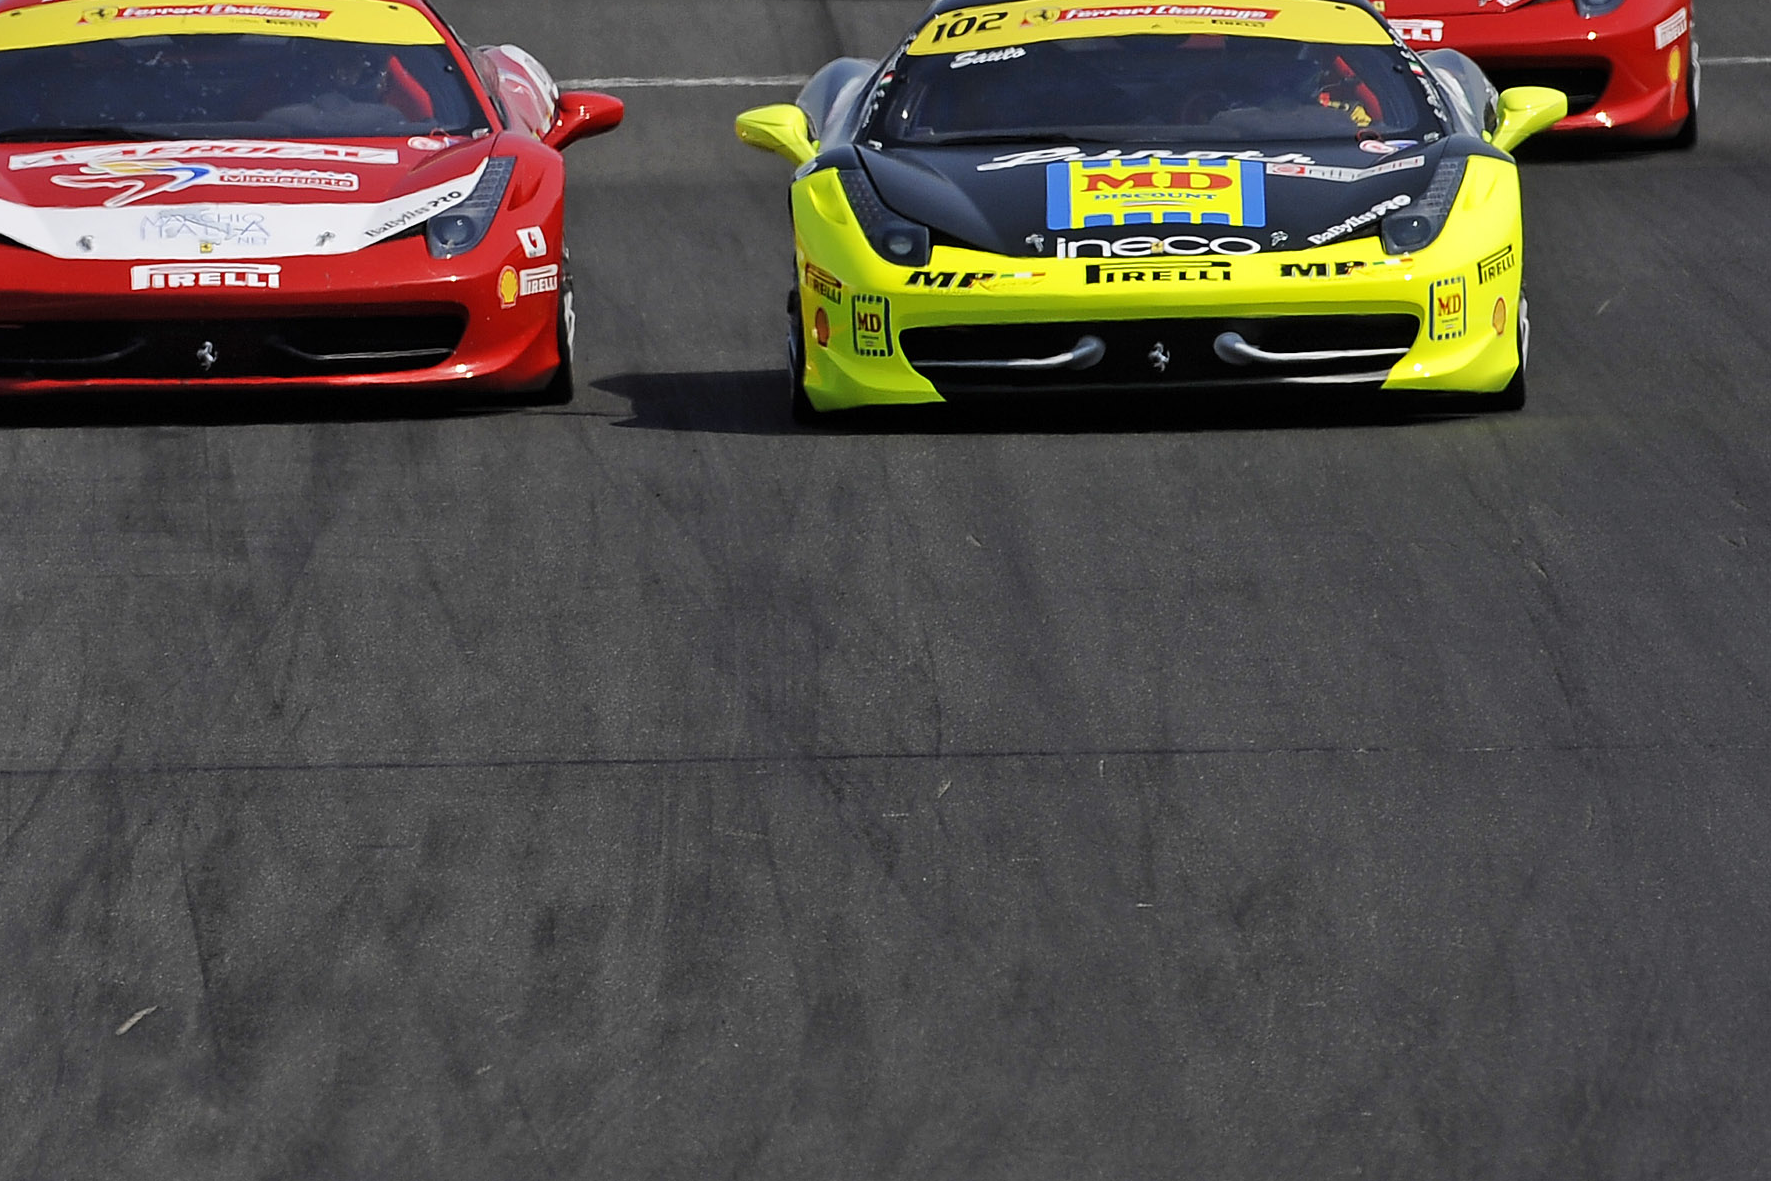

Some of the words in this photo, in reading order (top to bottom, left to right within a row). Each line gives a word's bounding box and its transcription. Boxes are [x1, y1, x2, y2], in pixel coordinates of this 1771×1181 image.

[121, 6, 210, 20] Ferrari
[212, 4, 322, 21] Challenge
[1064, 6, 1154, 20] Ferrari
[1155, 4, 1269, 20] Challenge
[931, 10, 1010, 44] 102
[1080, 169, 1235, 193] MD
[1093, 192, 1218, 202] DISCOUNT
[1084, 260, 1231, 285] PIRELLI
[1477, 244, 1515, 285] PIRELLI
[130, 263, 283, 291] PIRELLI
[518, 263, 559, 297] PIRELLI
[805, 262, 843, 305] PIRELLI
[1437, 293, 1462, 317] MD
[856, 312, 883, 334] MD
